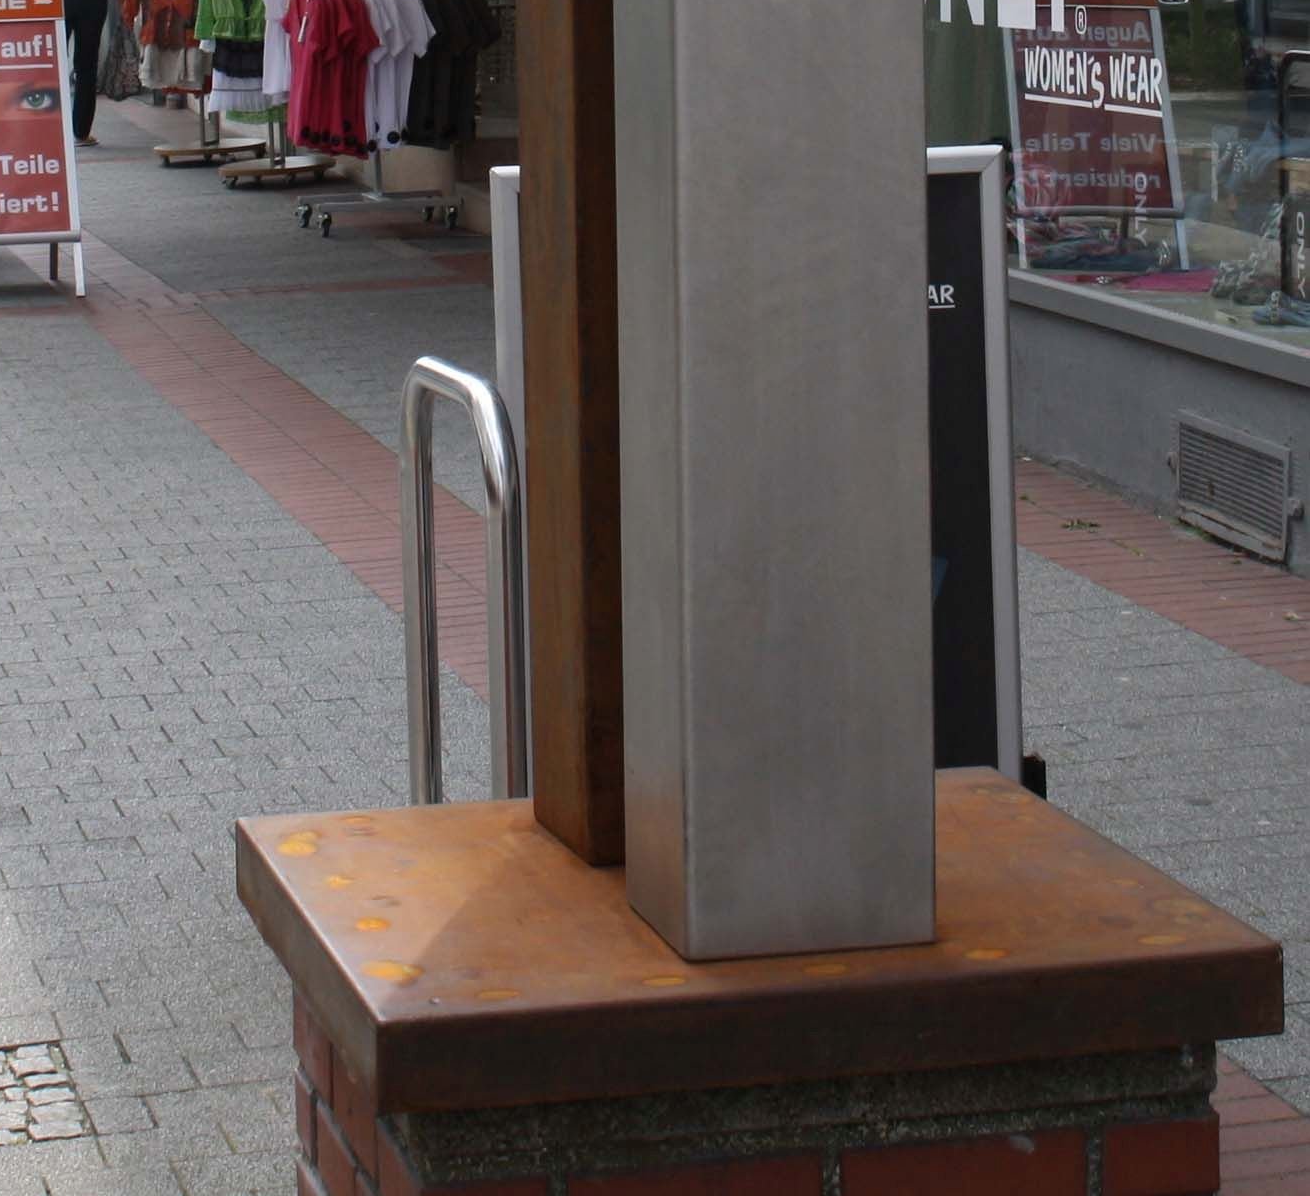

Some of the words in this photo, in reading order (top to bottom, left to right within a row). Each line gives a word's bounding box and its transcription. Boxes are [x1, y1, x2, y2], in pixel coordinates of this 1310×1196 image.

[1, 34, 54, 59] auf!
[1108, 52, 1163, 104] WEAR
[1295, 212, 1306, 298] ONLY
[928, 284, 955, 303] AR
